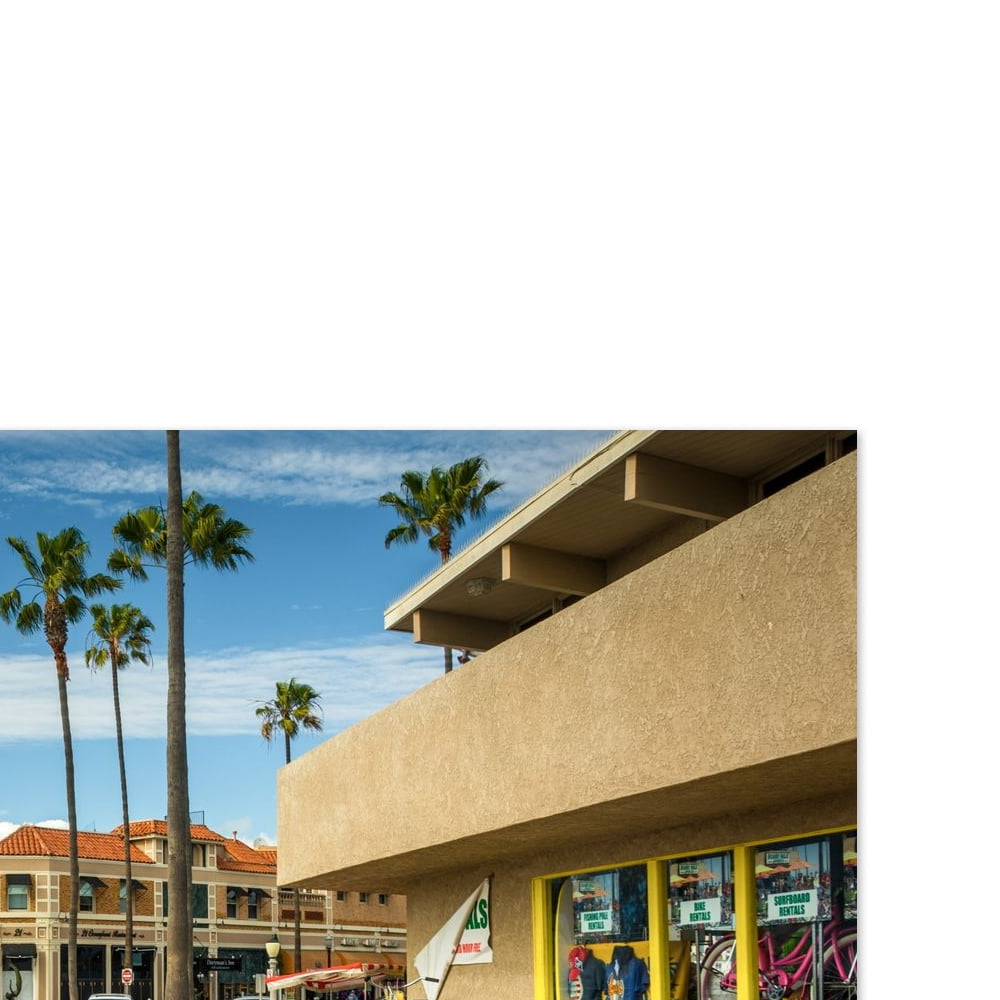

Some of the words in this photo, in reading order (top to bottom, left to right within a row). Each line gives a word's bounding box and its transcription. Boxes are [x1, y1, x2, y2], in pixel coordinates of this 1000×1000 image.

[774, 892, 810, 906] SURFBOARD
[694, 901, 706, 912] BIKE
[779, 904, 805, 917] RENTALS
[583, 912, 598, 921] FISHING
[599, 911, 609, 920] POLE
[689, 911, 711, 922] RENTALS
[588, 921, 605, 930] RENTALS
